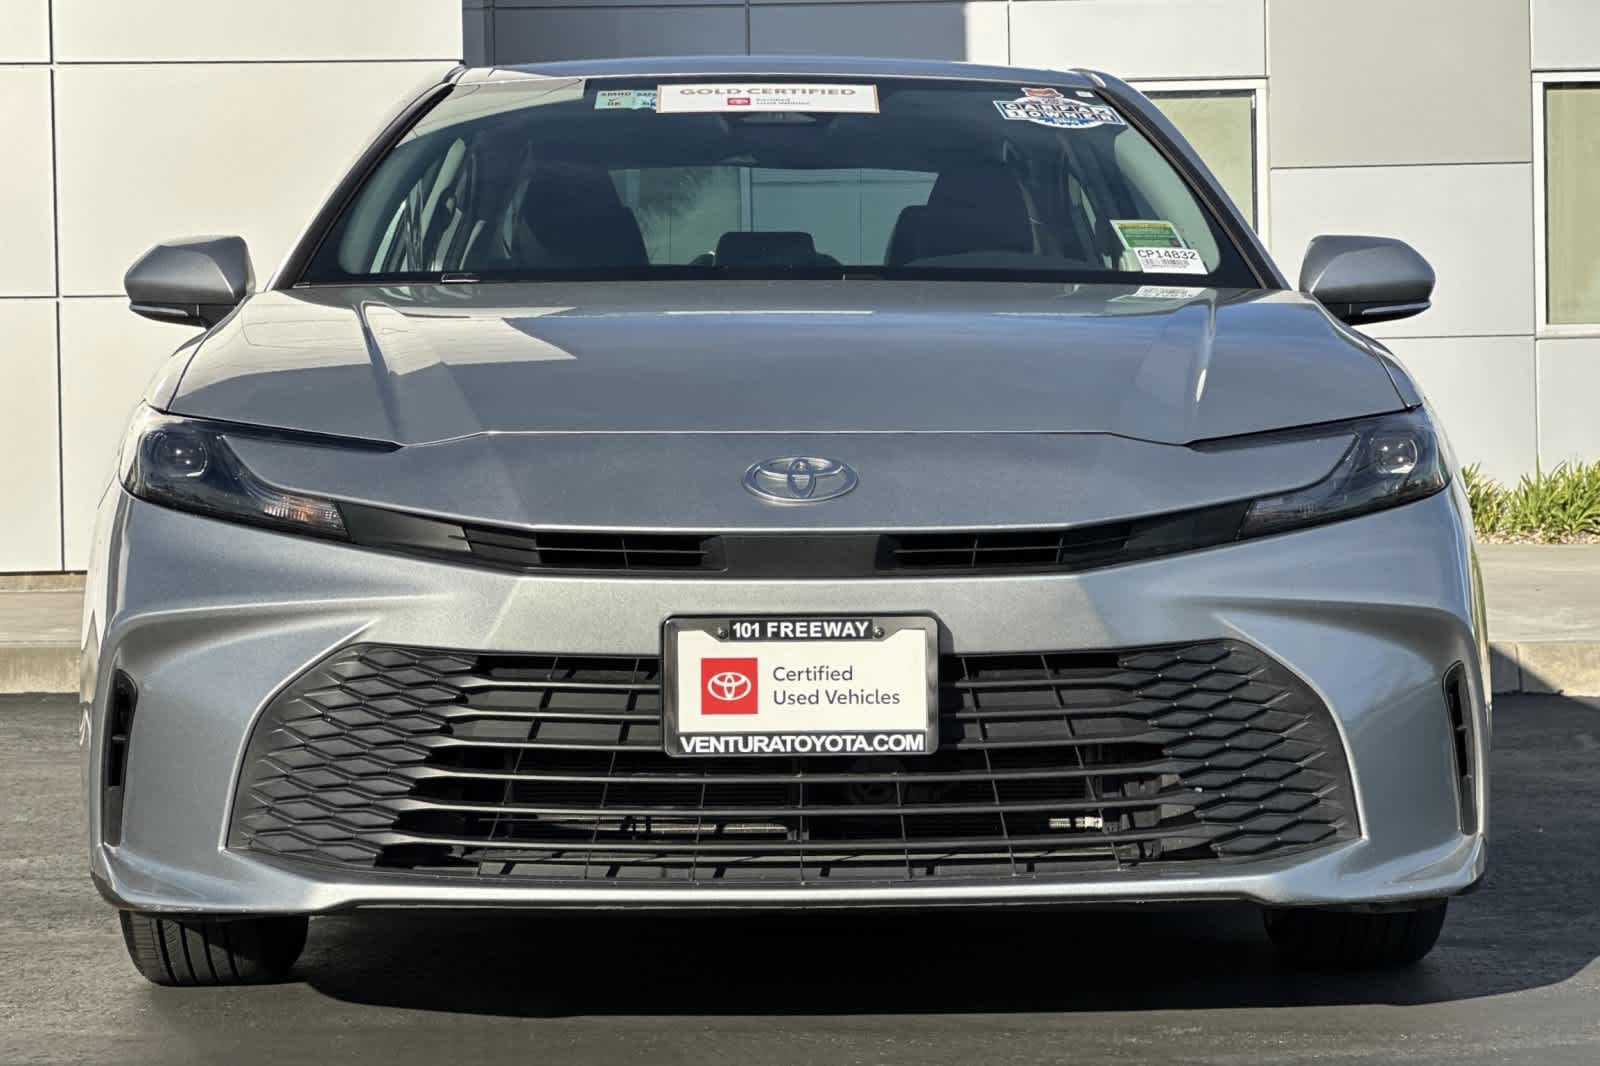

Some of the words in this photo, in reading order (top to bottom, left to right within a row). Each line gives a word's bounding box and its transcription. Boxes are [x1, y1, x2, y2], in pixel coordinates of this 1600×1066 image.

[1137, 249, 1197, 260] CP14832
[732, 622, 760, 638] 101
[767, 621, 869, 638] FREEWAY
[773, 665, 853, 681] Certified
[773, 689, 819, 705] Used
[825, 688, 901, 705] Vehicles
[680, 734, 924, 753] VENTURATOYOTA.COM
